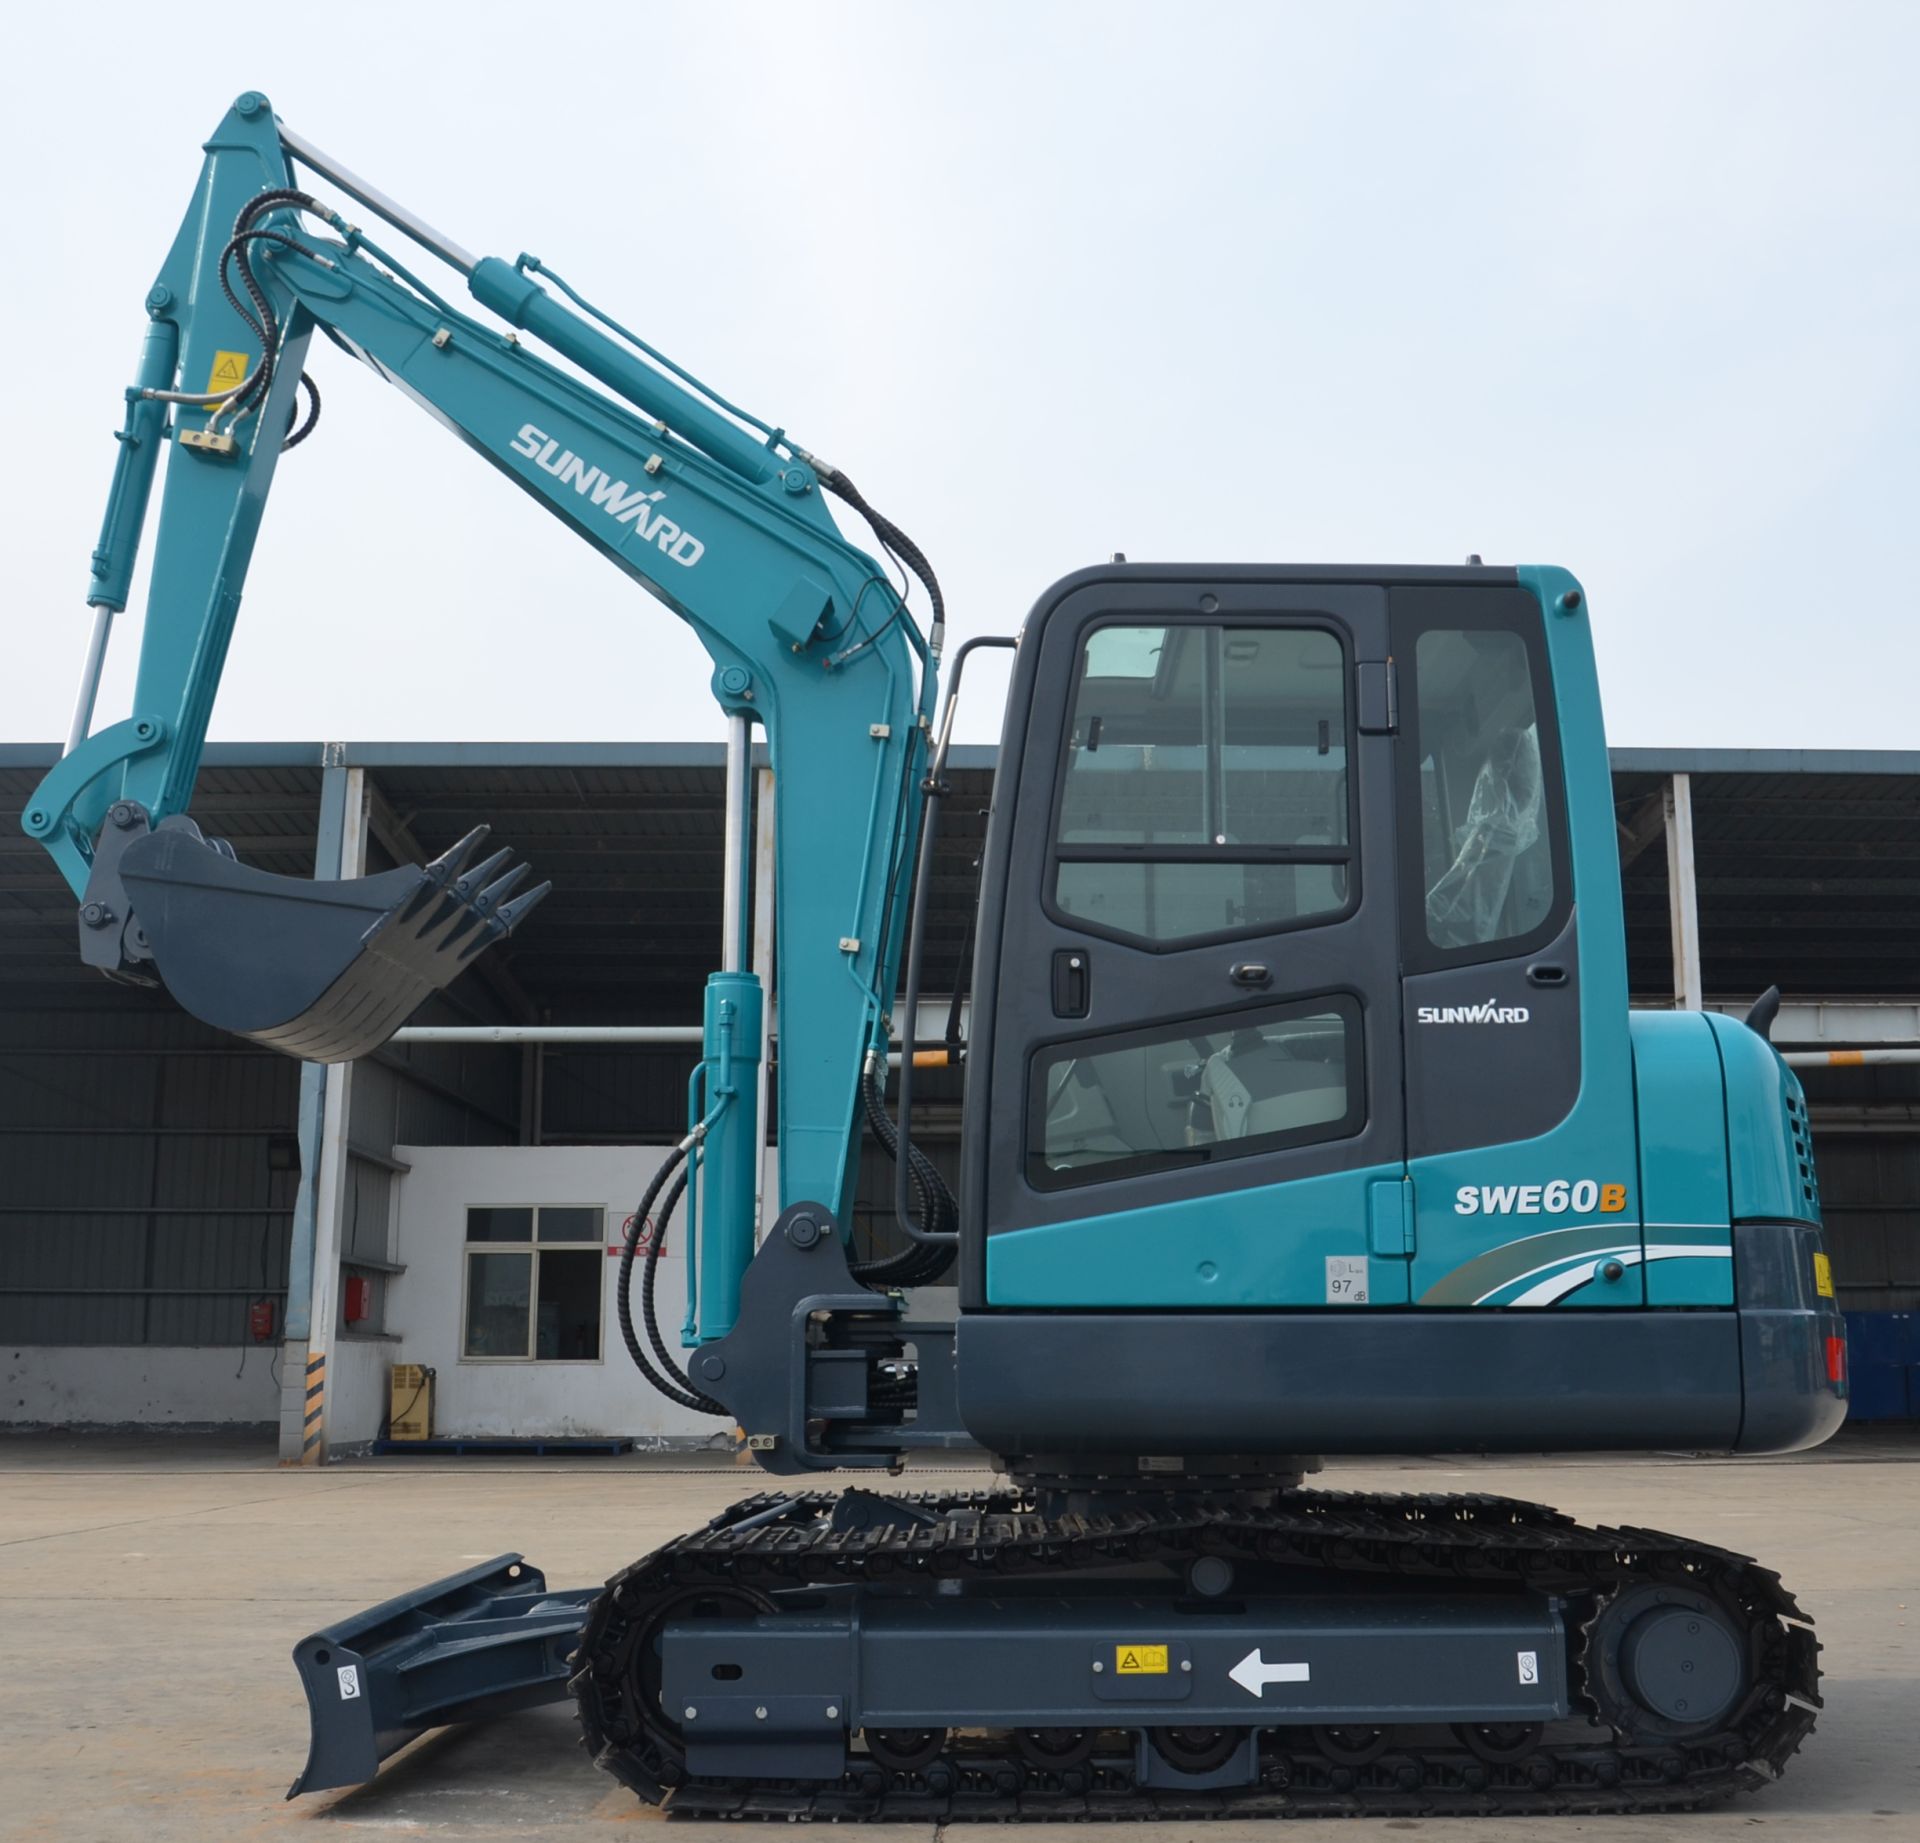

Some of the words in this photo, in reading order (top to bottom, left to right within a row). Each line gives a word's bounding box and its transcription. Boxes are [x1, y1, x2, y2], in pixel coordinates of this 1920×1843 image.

[509, 423, 705, 567] SUNWARD
[1418, 998, 1529, 1023] SUNWARD
[1454, 1179, 1627, 1215] SWE60B
[1332, 1280, 1352, 1293] 97
